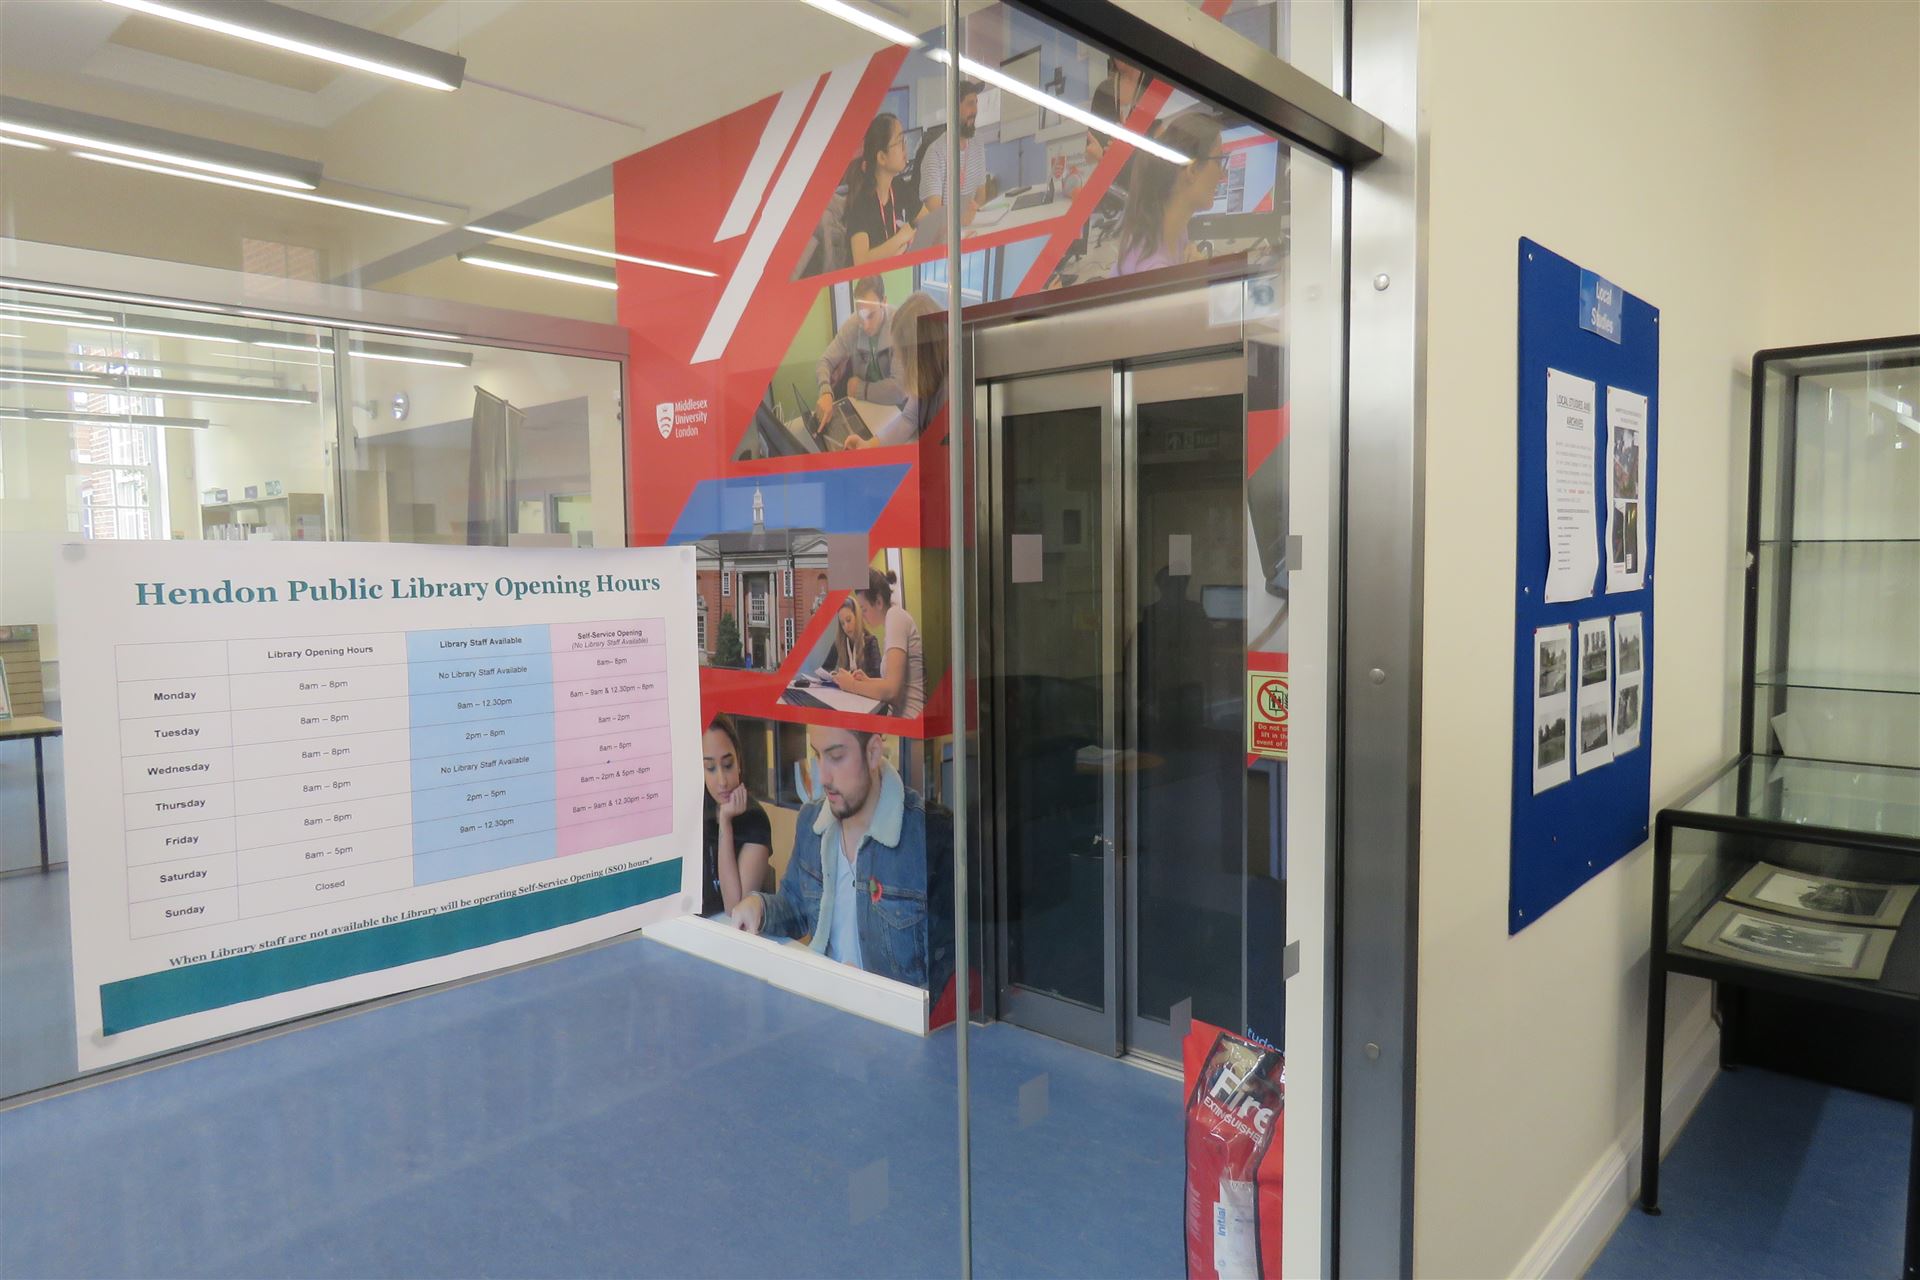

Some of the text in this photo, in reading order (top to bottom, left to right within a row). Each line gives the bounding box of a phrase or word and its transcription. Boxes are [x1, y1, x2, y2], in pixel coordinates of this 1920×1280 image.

[1596, 281, 1612, 306] Local
[675, 399, 708, 411] Middlesex
[675, 410, 708, 424] University
[675, 425, 699, 438] London
[135, 574, 661, 605] Hendon Public Library Opening Hours
[577, 629, 643, 640] Self-Service Opening
[439, 636, 522, 650] Library Staff Available
[571, 642, 583, 650] (No
[267, 645, 374, 660] Library Opening Hours
[451, 671, 476, 679] Library
[478, 668, 495, 676] Staff
[496, 666, 528, 674] Available
[299, 683, 318, 691] 8am
[329, 680, 348, 689] 8pm
[153, 691, 197, 702] Monday
[457, 702, 473, 710] 9am
[482, 698, 513, 707] 12.30pm
[300, 717, 320, 725] 8am
[330, 714, 349, 723] 8pm
[154, 727, 200, 738] Tuesday
[465, 732, 482, 740] 2pm
[490, 729, 506, 738] 8pm
[301, 751, 321, 759] 8am
[331, 747, 350, 757] 8pm
[147, 763, 210, 776] Wednesday
[453, 763, 478, 773] Library
[480, 760, 497, 769] Staff
[498, 756, 530, 766] Available
[601, 773, 615, 781] 2pm
[302, 785, 322, 793] 8am
[332, 780, 351, 790] 8pm
[466, 793, 483, 802] 2pm
[490, 790, 506, 799] 5pm
[155, 799, 206, 812] Thursday
[303, 818, 323, 826] 8am
[333, 813, 352, 823] 8pm
[460, 825, 476, 834] 9am
[484, 818, 514, 829] 12.30pm
[165, 835, 199, 847] Friday
[304, 851, 324, 860] 8am
[334, 846, 353, 856] 5pm
[159, 868, 208, 883] Saturday
[315, 880, 346, 891] Closed
[165, 905, 206, 918] Sunday
[169, 952, 207, 967] When
[211, 943, 257, 960] Library
[258, 936, 287, 950] staff
[288, 934, 307, 943] are
[310, 928, 329, 939] not
[331, 918, 380, 935] available
[382, 913, 398, 924] the
[401, 906, 439, 921] Library
[440, 900, 458, 911] will
[460, 898, 472, 907] be
[473, 888, 517, 905] operating
[518, 877, 569, 895] Self-Service
[570, 869, 604, 884] Opening
[604, 863, 627, 875] (SSO)
[1209, 1064, 1273, 1135] Fire
[1217, 1207, 1226, 1236] Initial
